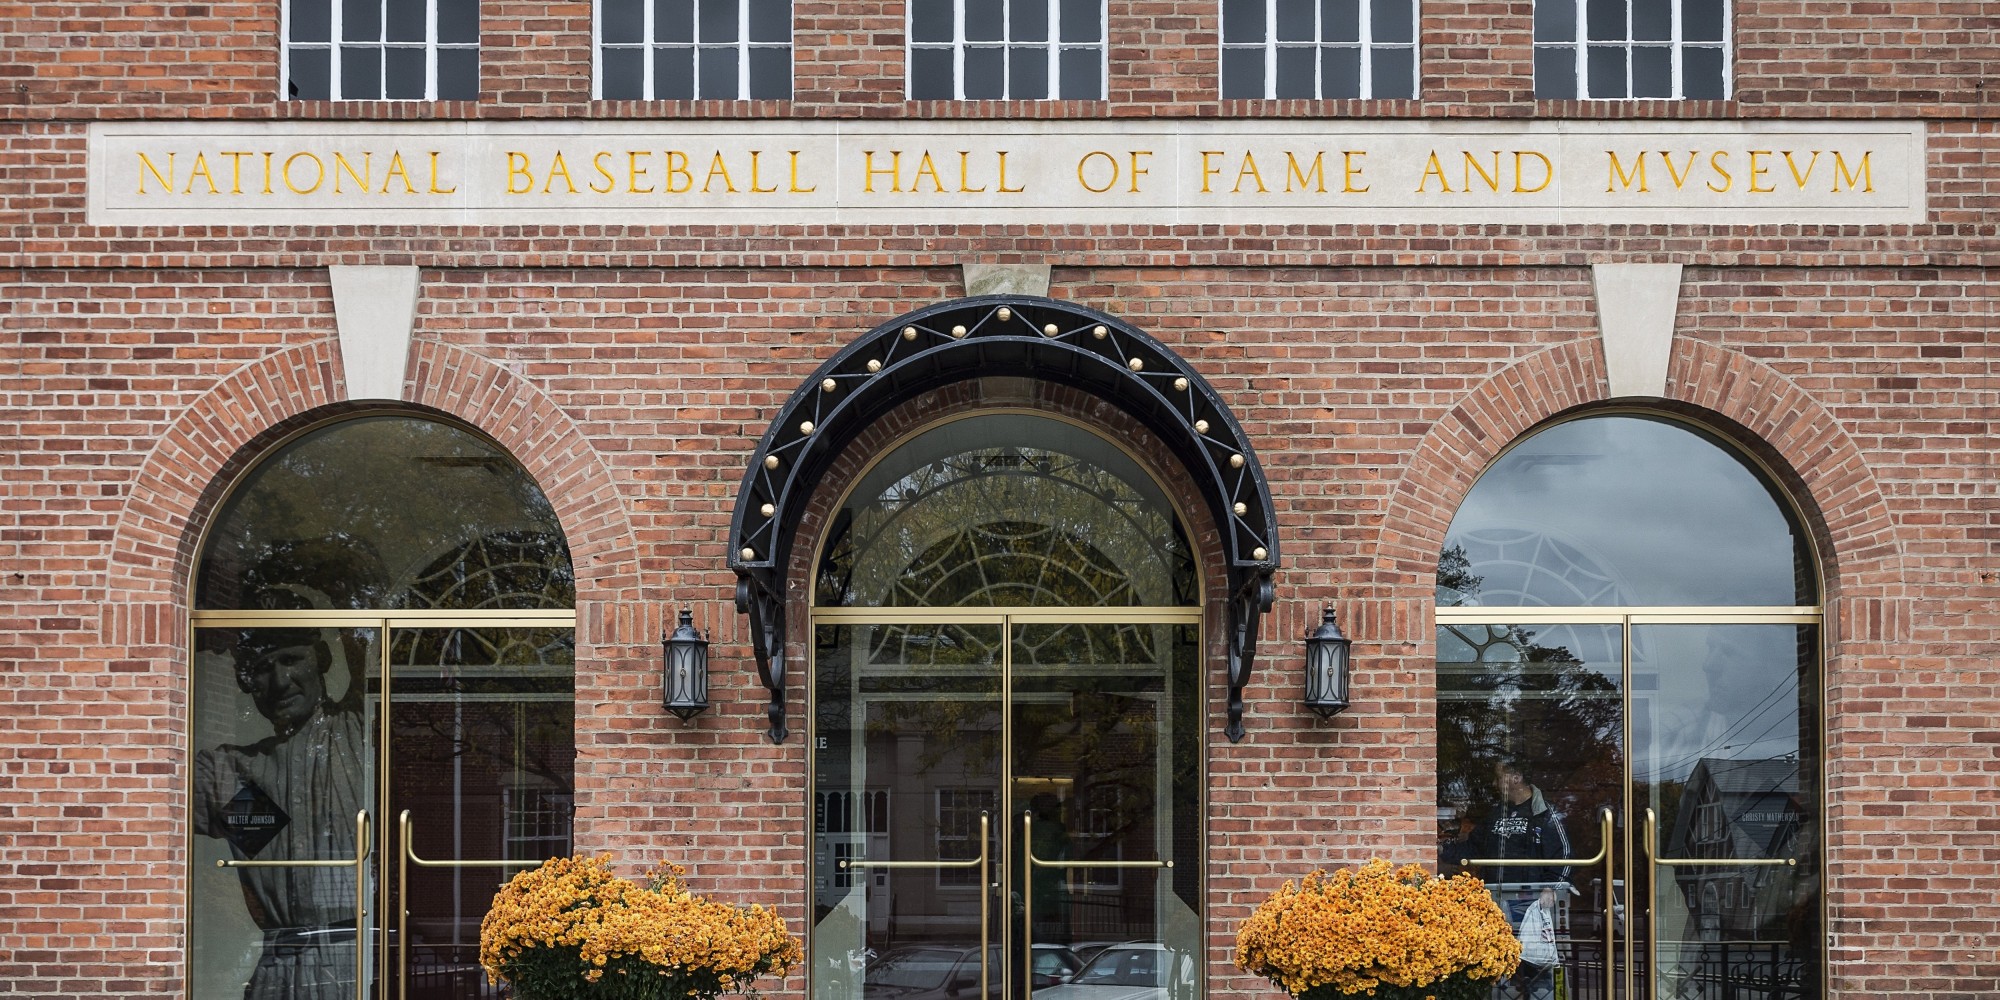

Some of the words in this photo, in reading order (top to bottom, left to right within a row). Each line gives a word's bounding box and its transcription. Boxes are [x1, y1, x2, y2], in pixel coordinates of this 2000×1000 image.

[136, 150, 457, 195] NATIONAL
[505, 149, 817, 195] BASEBALL
[863, 150, 1026, 194] HALL
[1077, 150, 1154, 194] OF
[1200, 149, 1371, 194] FAME
[1416, 149, 1554, 194] AND
[227, 815, 249, 824] WALTER
[250, 815, 275, 824] JOHNSON
[1742, 812, 1765, 822] CHRISTY
